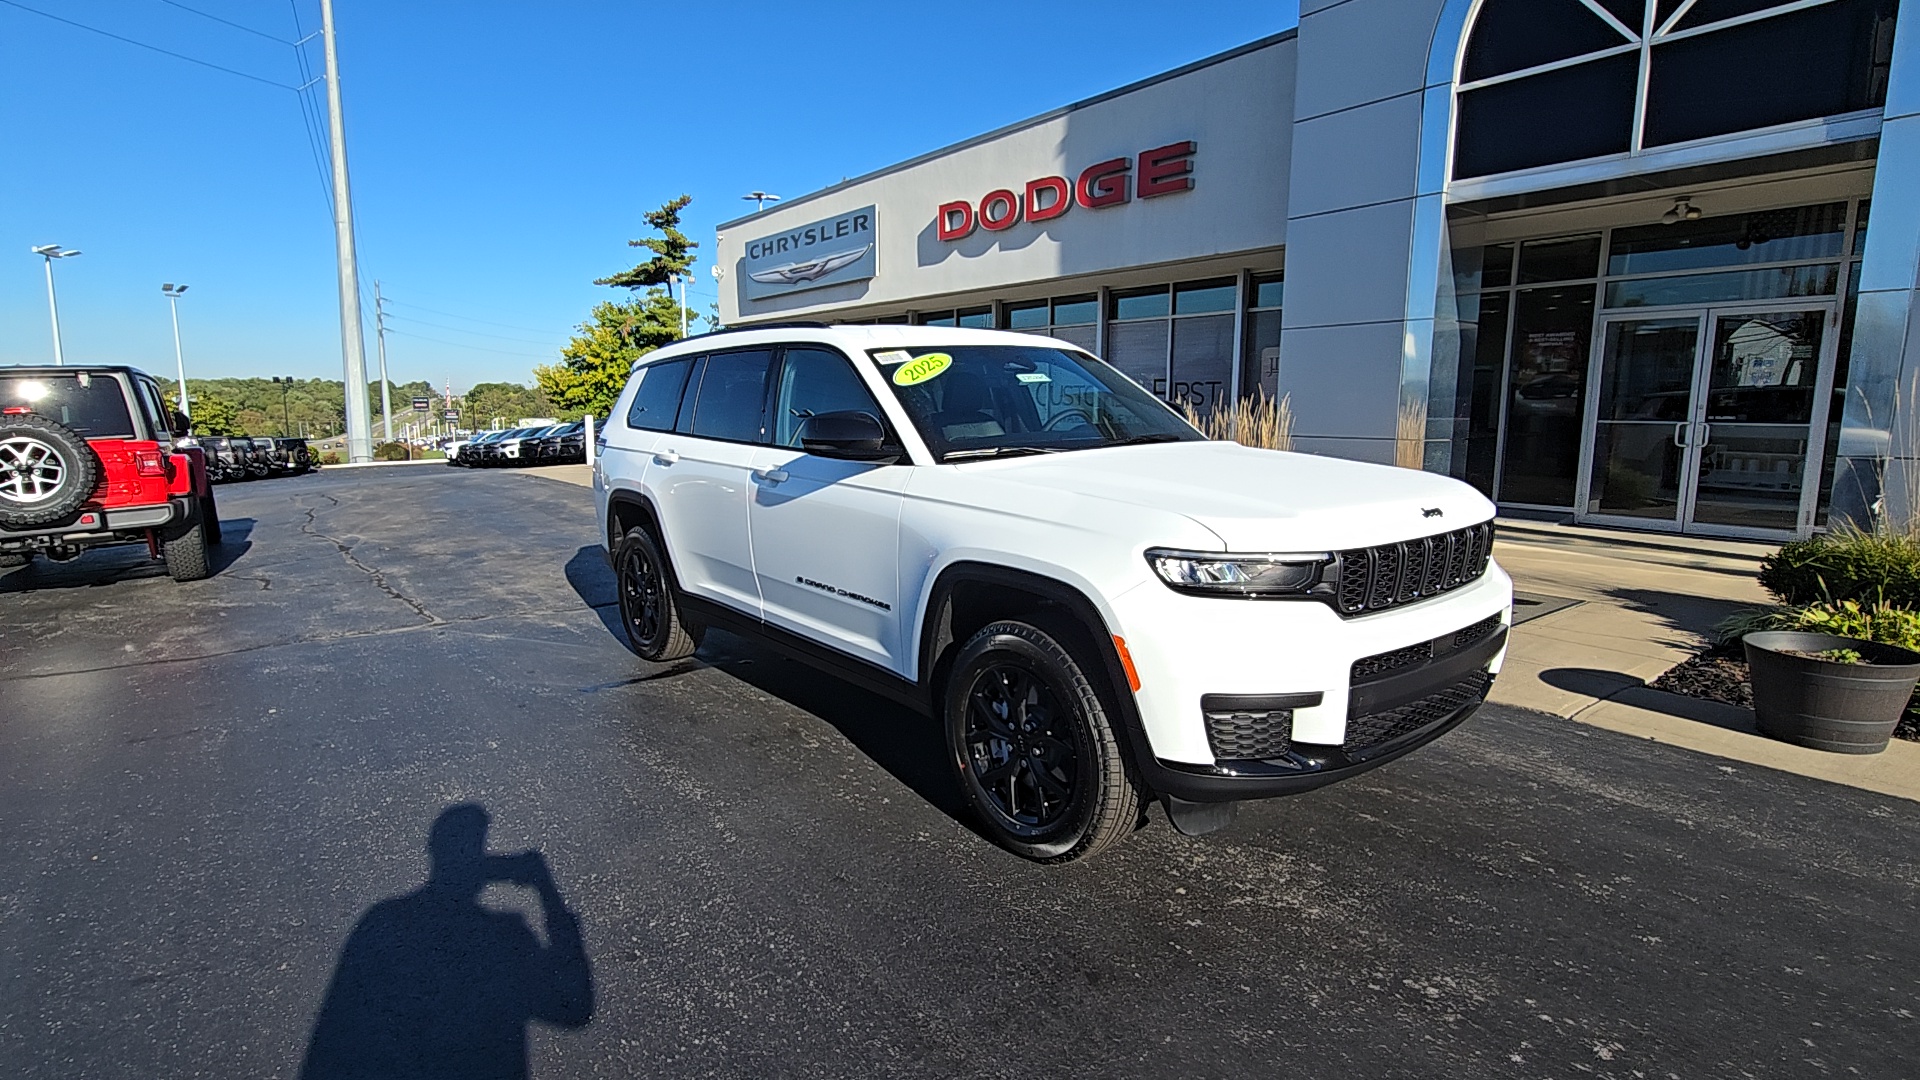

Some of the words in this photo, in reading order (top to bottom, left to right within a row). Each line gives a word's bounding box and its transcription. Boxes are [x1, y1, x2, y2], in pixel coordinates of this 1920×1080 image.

[937, 140, 1197, 242] DODGE
[749, 214, 869, 260] CHRYSLER
[904, 355, 944, 381] 2025
[804, 578, 836, 594] GRAND
[837, 588, 892, 612] CHEROKEE
